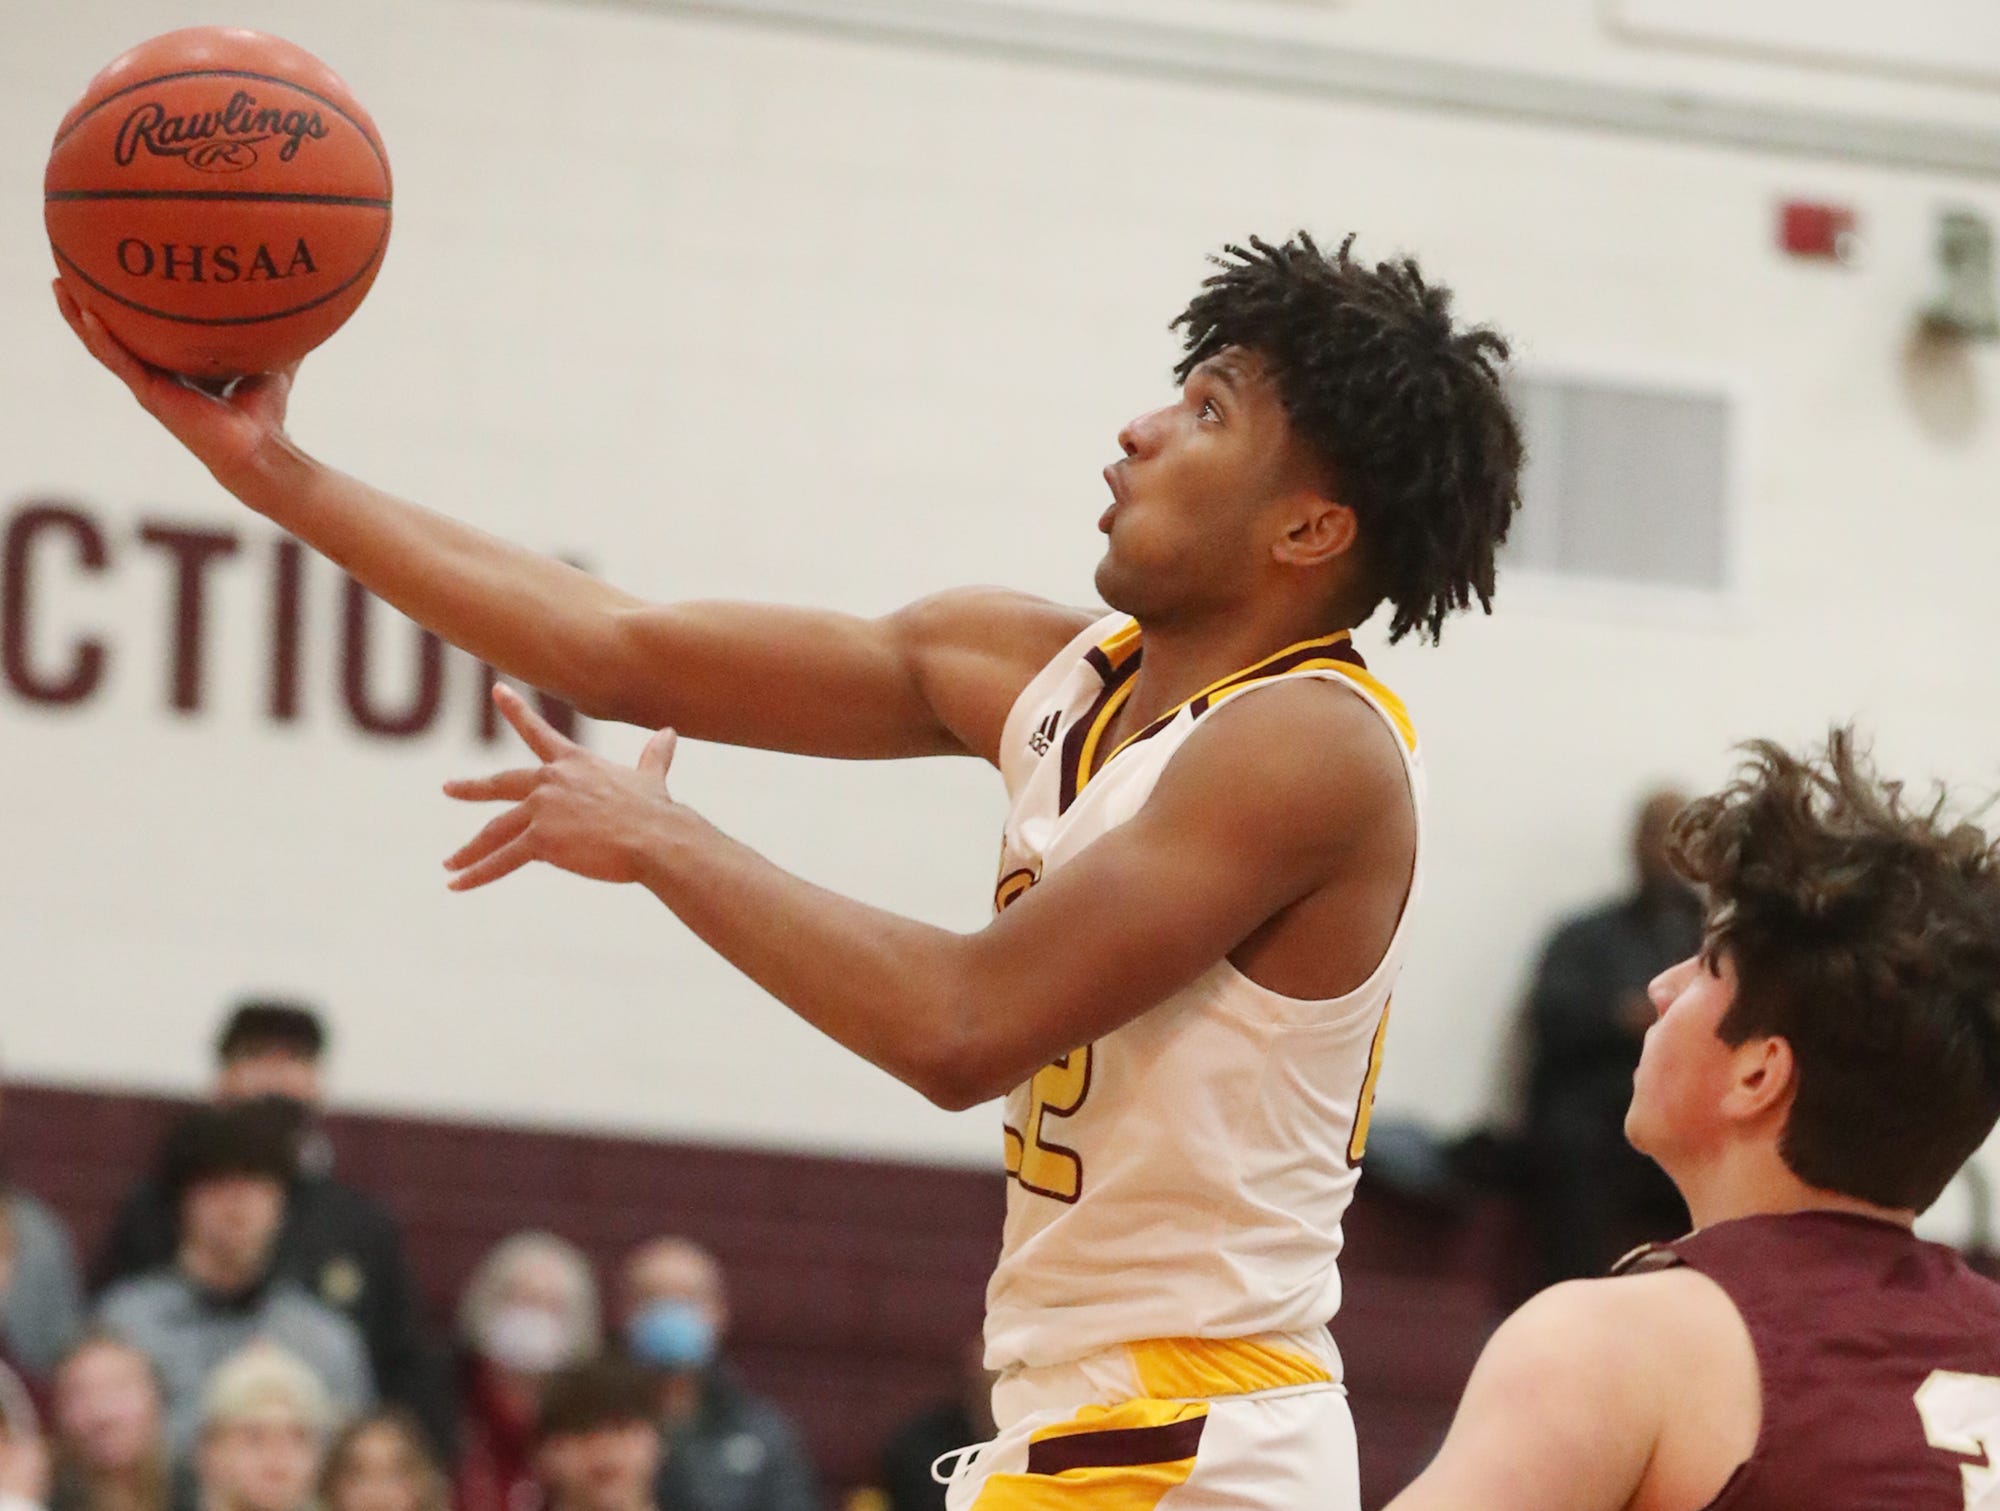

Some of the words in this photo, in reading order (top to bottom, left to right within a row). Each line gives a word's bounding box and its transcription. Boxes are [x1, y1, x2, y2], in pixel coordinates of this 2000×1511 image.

[115, 91, 329, 167] Rawlings
[116, 238, 318, 283] OHSAA
[1003, 1043, 1093, 1204] 2
